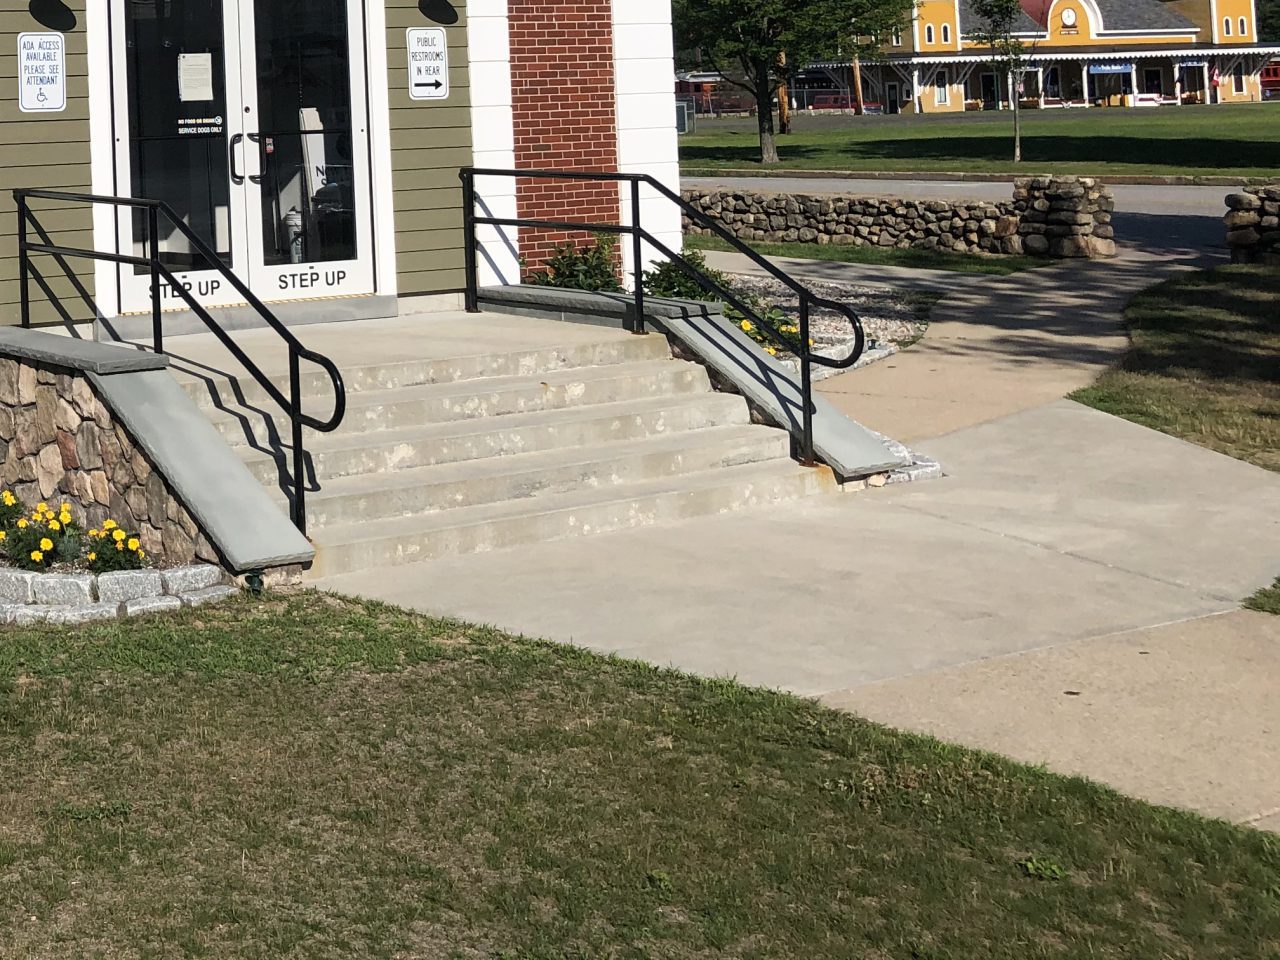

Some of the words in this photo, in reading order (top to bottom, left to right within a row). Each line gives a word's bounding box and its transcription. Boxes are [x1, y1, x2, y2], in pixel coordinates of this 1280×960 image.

[23, 41, 34, 50] ADA
[38, 40, 60, 51] ACCESS
[417, 37, 436, 46] PUBLIC
[25, 51, 57, 61] AVAILABLE
[411, 52, 443, 61] RESTROOMS
[23, 64, 46, 75] PLEASE
[49, 65, 59, 74] SEE
[416, 67, 422, 76] IN
[425, 66, 440, 75] REAR
[26, 75, 58, 86] ATTENDANT
[197, 126, 210, 134] DOGS
[278, 271, 320, 290] STEP
[324, 270, 347, 287] UP
[198, 279, 221, 296] UP
